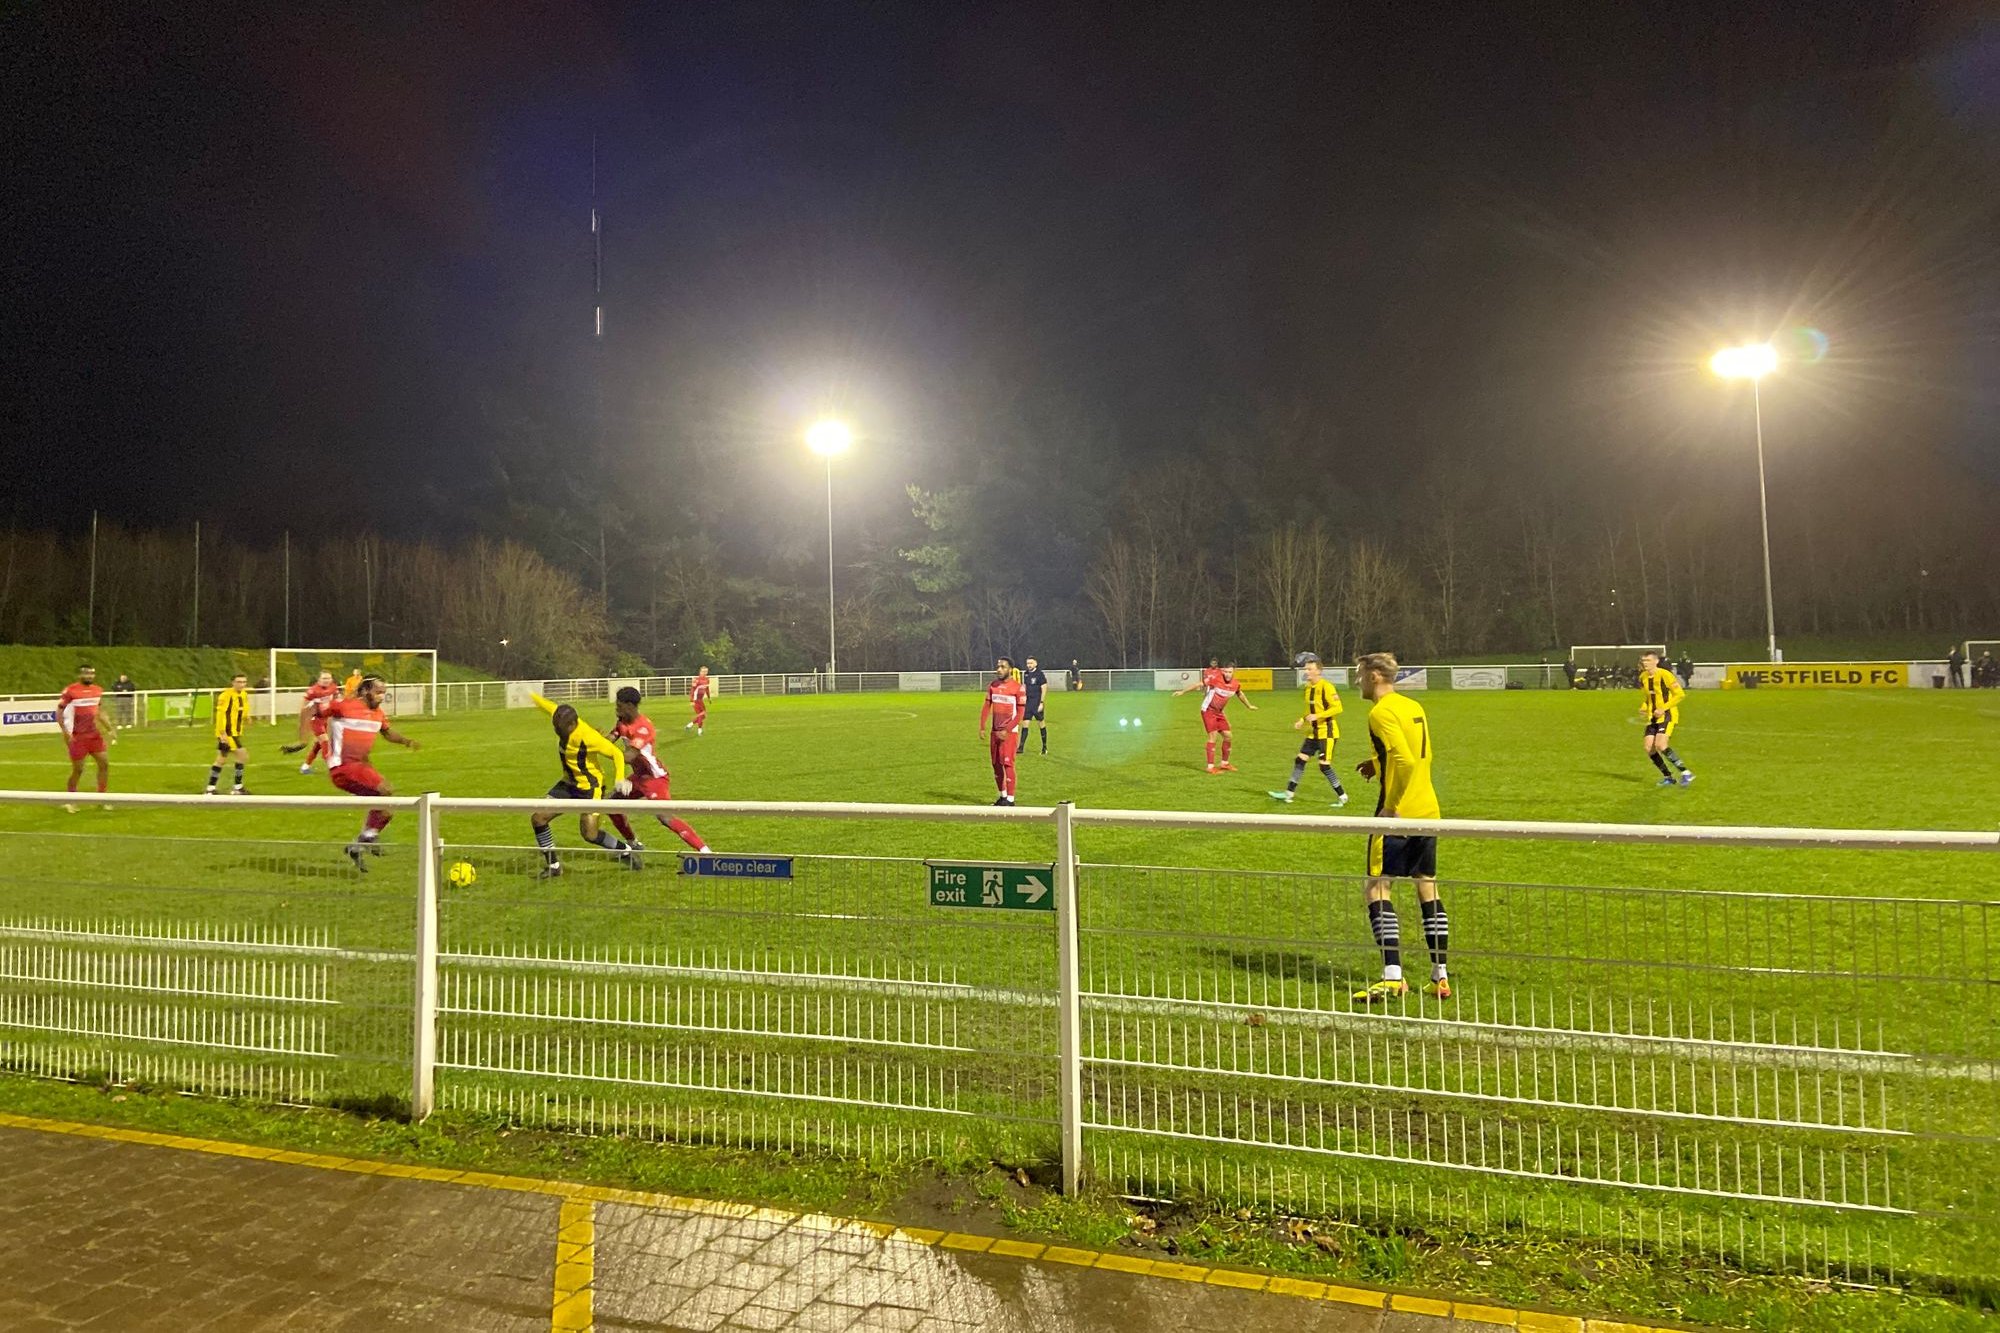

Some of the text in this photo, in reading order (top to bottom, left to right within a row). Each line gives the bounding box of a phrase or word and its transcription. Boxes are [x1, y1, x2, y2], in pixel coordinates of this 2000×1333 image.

[1736, 670, 1898, 684] WESTFIELD FC
[6, 712, 54, 723] PEACOCK
[1413, 716, 1427, 759] 7
[712, 859, 777, 875] Keep clear
[934, 870, 966, 885] Fire
[935, 888, 966, 903] exit
